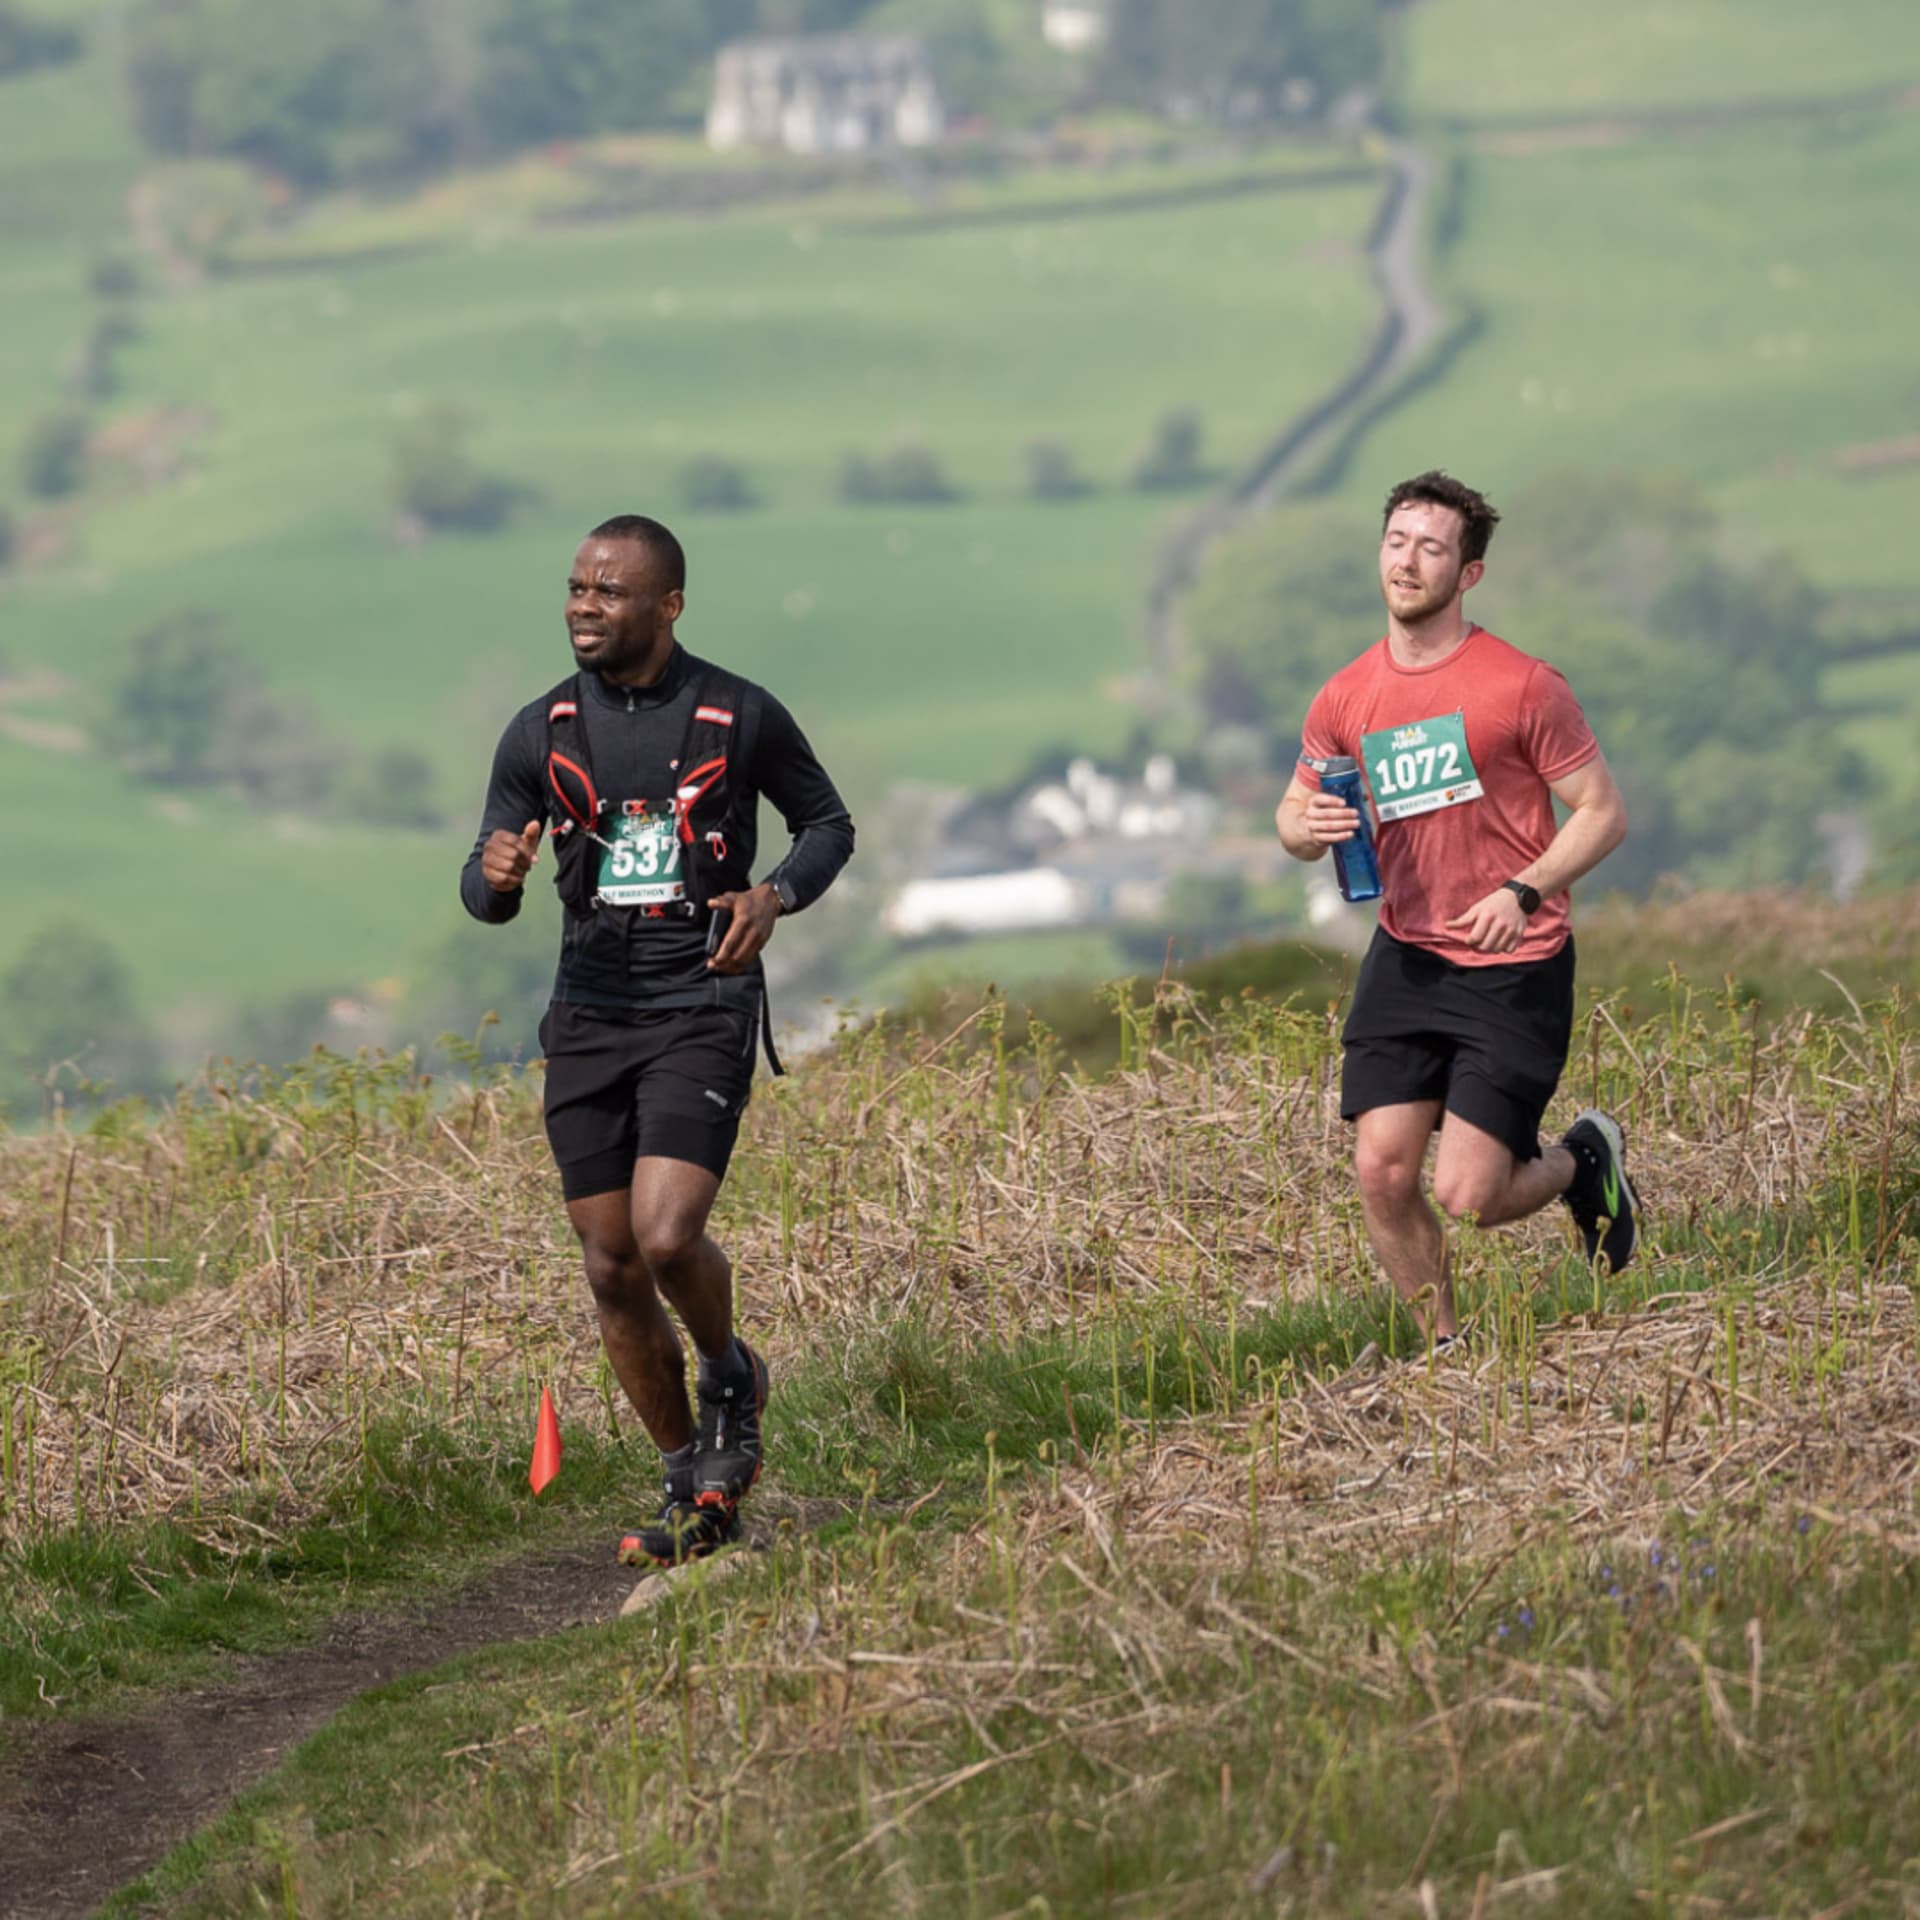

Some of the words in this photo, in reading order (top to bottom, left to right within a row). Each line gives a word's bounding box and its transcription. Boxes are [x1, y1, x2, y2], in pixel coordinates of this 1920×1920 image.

[1375, 742, 1463, 796] 1072
[611, 835, 681, 878] 537
[618, 887, 665, 899] MARATHON
